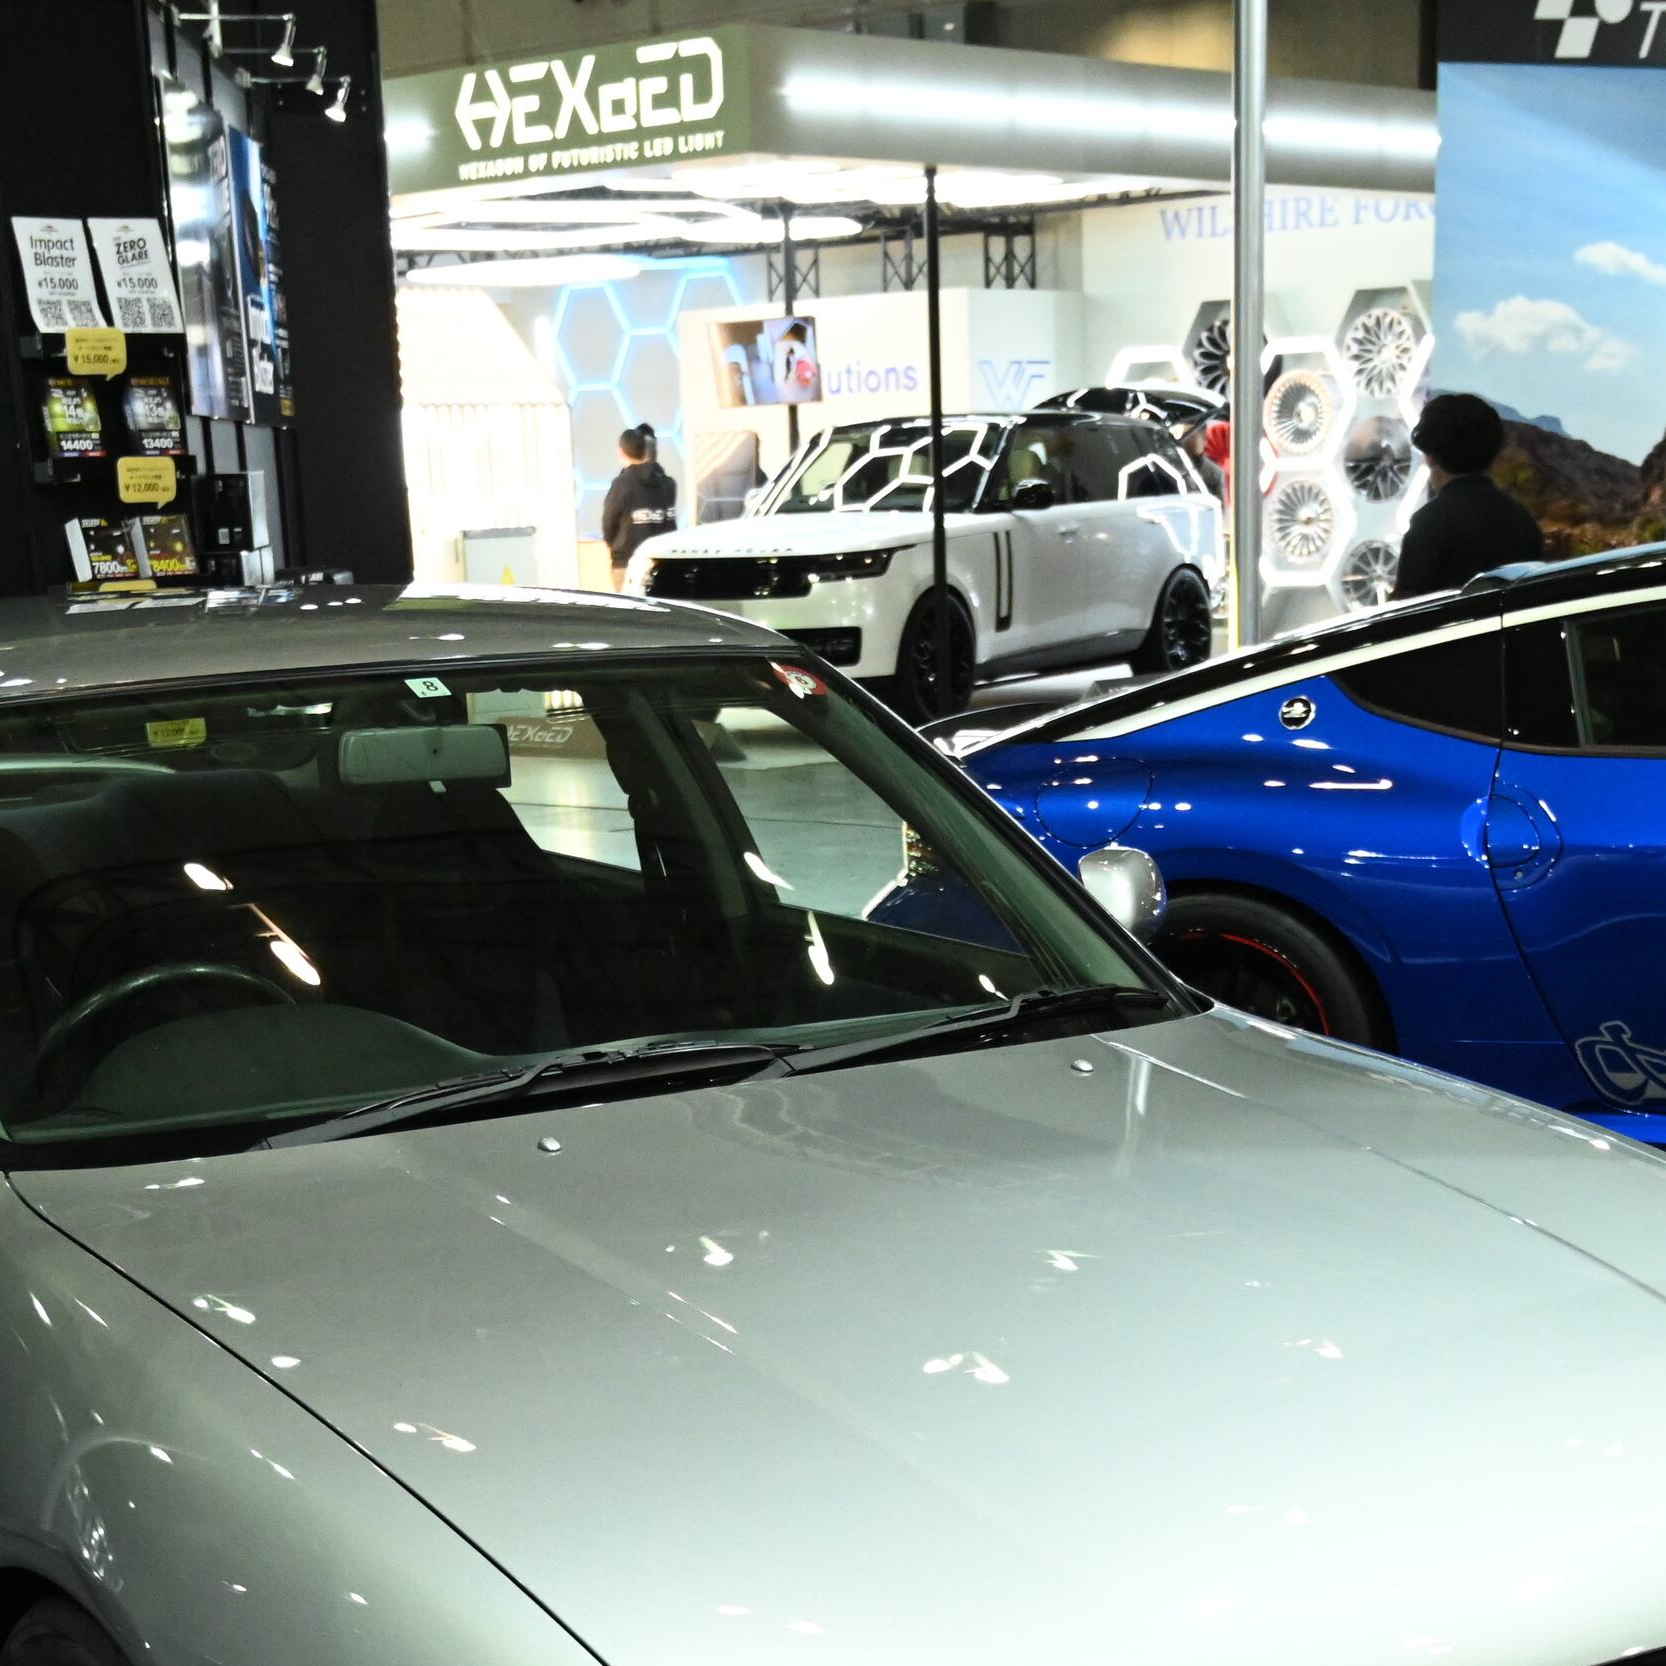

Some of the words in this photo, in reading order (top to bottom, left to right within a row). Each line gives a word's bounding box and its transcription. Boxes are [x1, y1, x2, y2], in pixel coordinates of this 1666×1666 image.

[528, 153, 548, 172] OF
[551, 141, 639, 169] FUTURISTIC
[643, 137, 674, 157] LED
[678, 130, 725, 152] LIGHT
[1159, 196, 1341, 241] WILHIRE
[1351, 197, 1436, 225] FOR
[29, 236, 75, 252] Impact
[115, 238, 147, 255] ZERO
[34, 252, 77, 268] Blaster
[118, 250, 149, 265] GLARE
[827, 361, 918, 394] utions
[422, 680, 439, 692] 8
